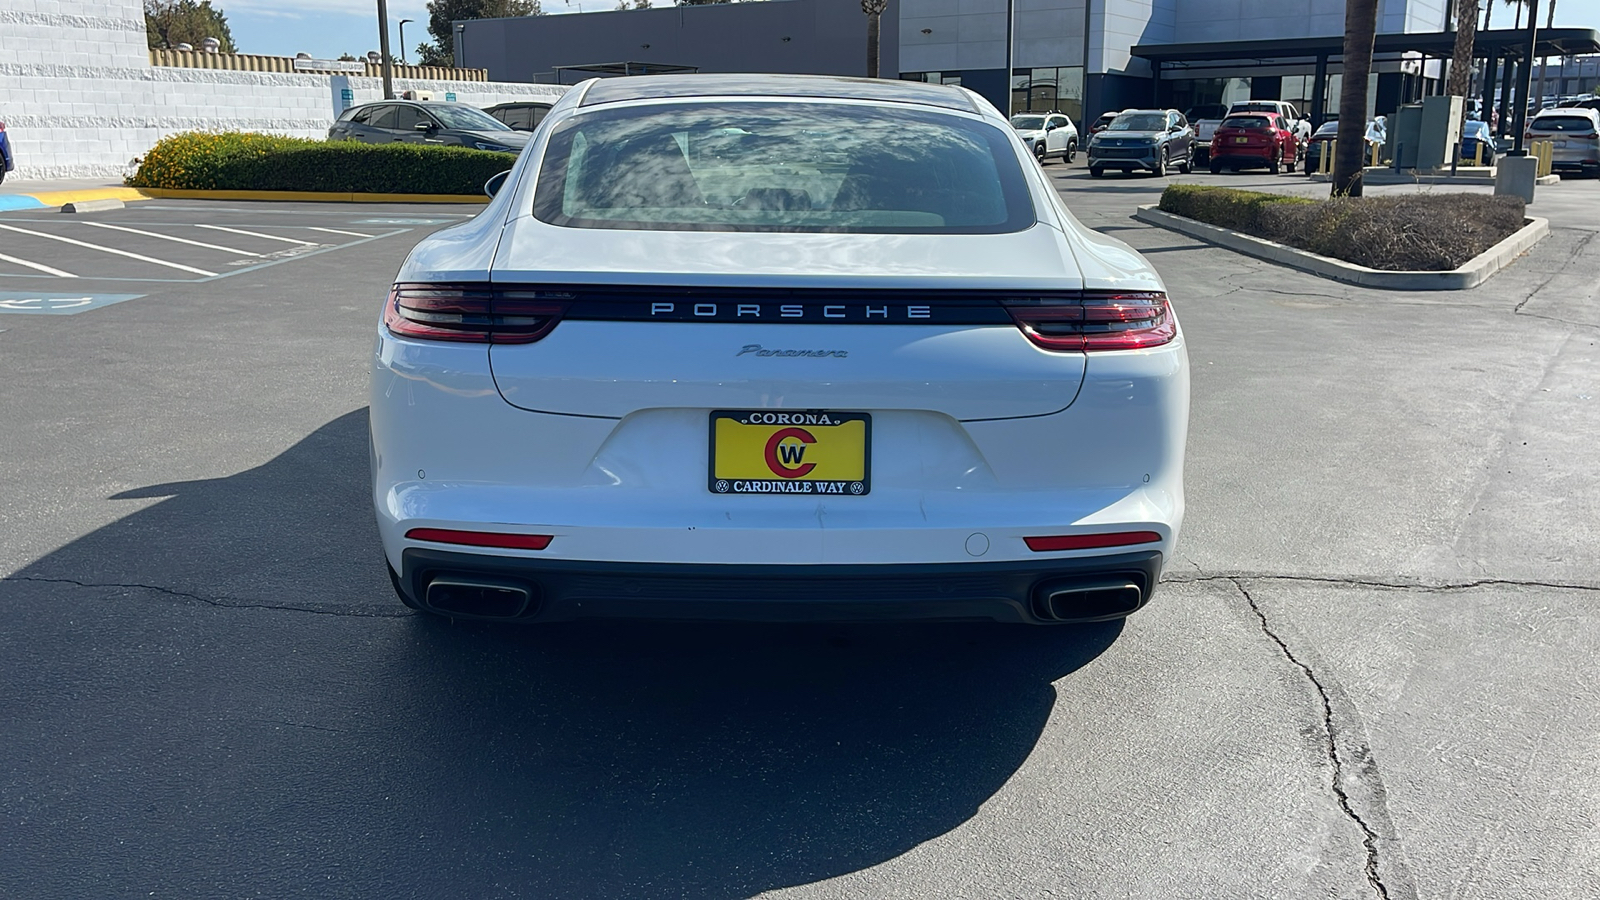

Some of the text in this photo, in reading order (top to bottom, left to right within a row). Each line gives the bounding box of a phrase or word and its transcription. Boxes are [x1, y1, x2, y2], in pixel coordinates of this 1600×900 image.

[650, 302, 931, 319] PORSCHE
[736, 344, 849, 358] Panamera
[749, 412, 832, 425] CORONA
[733, 480, 846, 494] CARDINALE WAY
